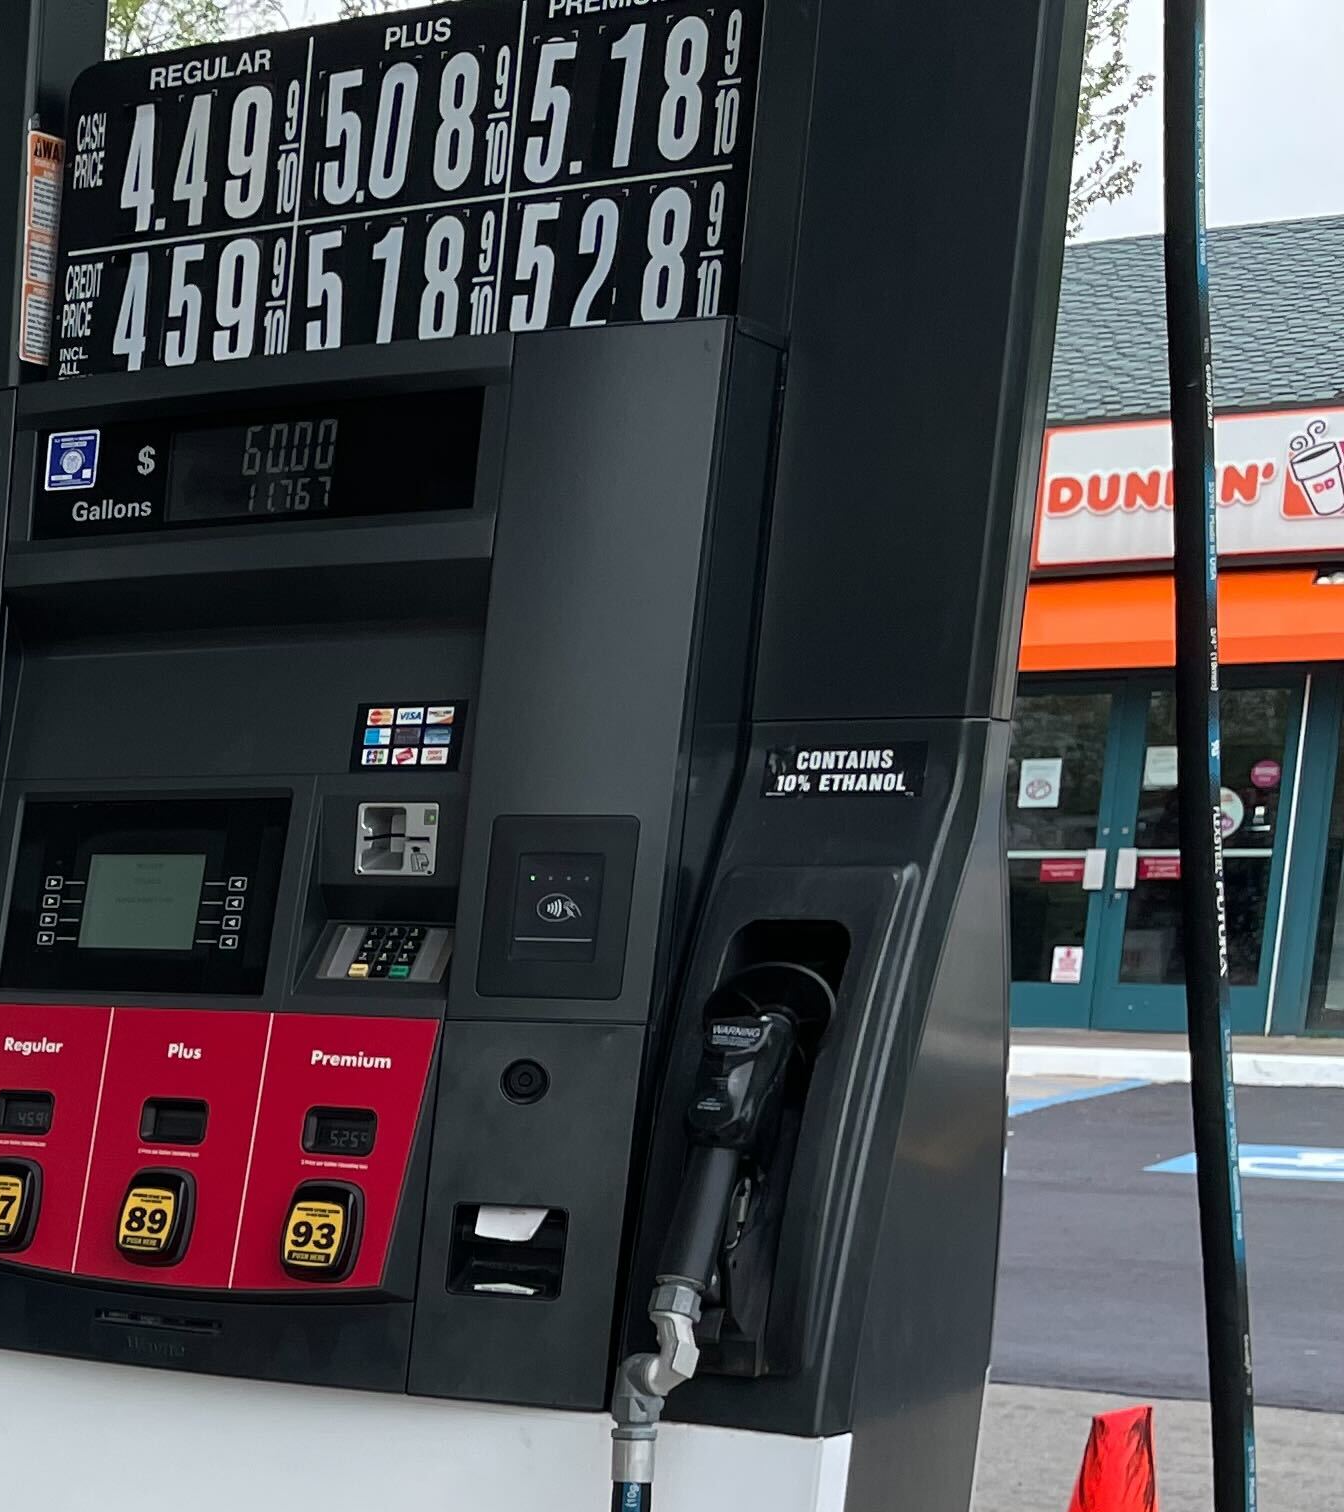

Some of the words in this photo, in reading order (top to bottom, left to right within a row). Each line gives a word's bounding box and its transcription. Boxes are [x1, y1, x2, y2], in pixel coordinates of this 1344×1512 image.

[548, 0, 659, 18] PREM
[384, 17, 452, 51] PLUS
[149, 49, 272, 91] REGULAR
[77, 112, 107, 152] CASH
[73, 151, 105, 190] PRICE
[65, 262, 104, 301] CREDIT
[60, 301, 94, 339] PRICE
[59, 347, 89, 362] INCL.
[58, 362, 80, 376] ALL
[136, 444, 156, 476] $
[1047, 462, 1276, 515] DUNN'
[72, 499, 152, 523] Gallons
[400, 711, 422, 721] VISA
[796, 749, 894, 771] CONTAINS
[777, 774, 811, 793] 10%
[818, 771, 906, 792] ETHANOL
[1215, 880, 1228, 978] FUTURA
[712, 1025, 761, 1038] WARNING
[3, 1036, 64, 1056] Regular
[167, 1042, 202, 1060] Plus
[310, 1049, 392, 1069] Premium
[124, 1206, 168, 1235] 89
[290, 1220, 336, 1250] 93
